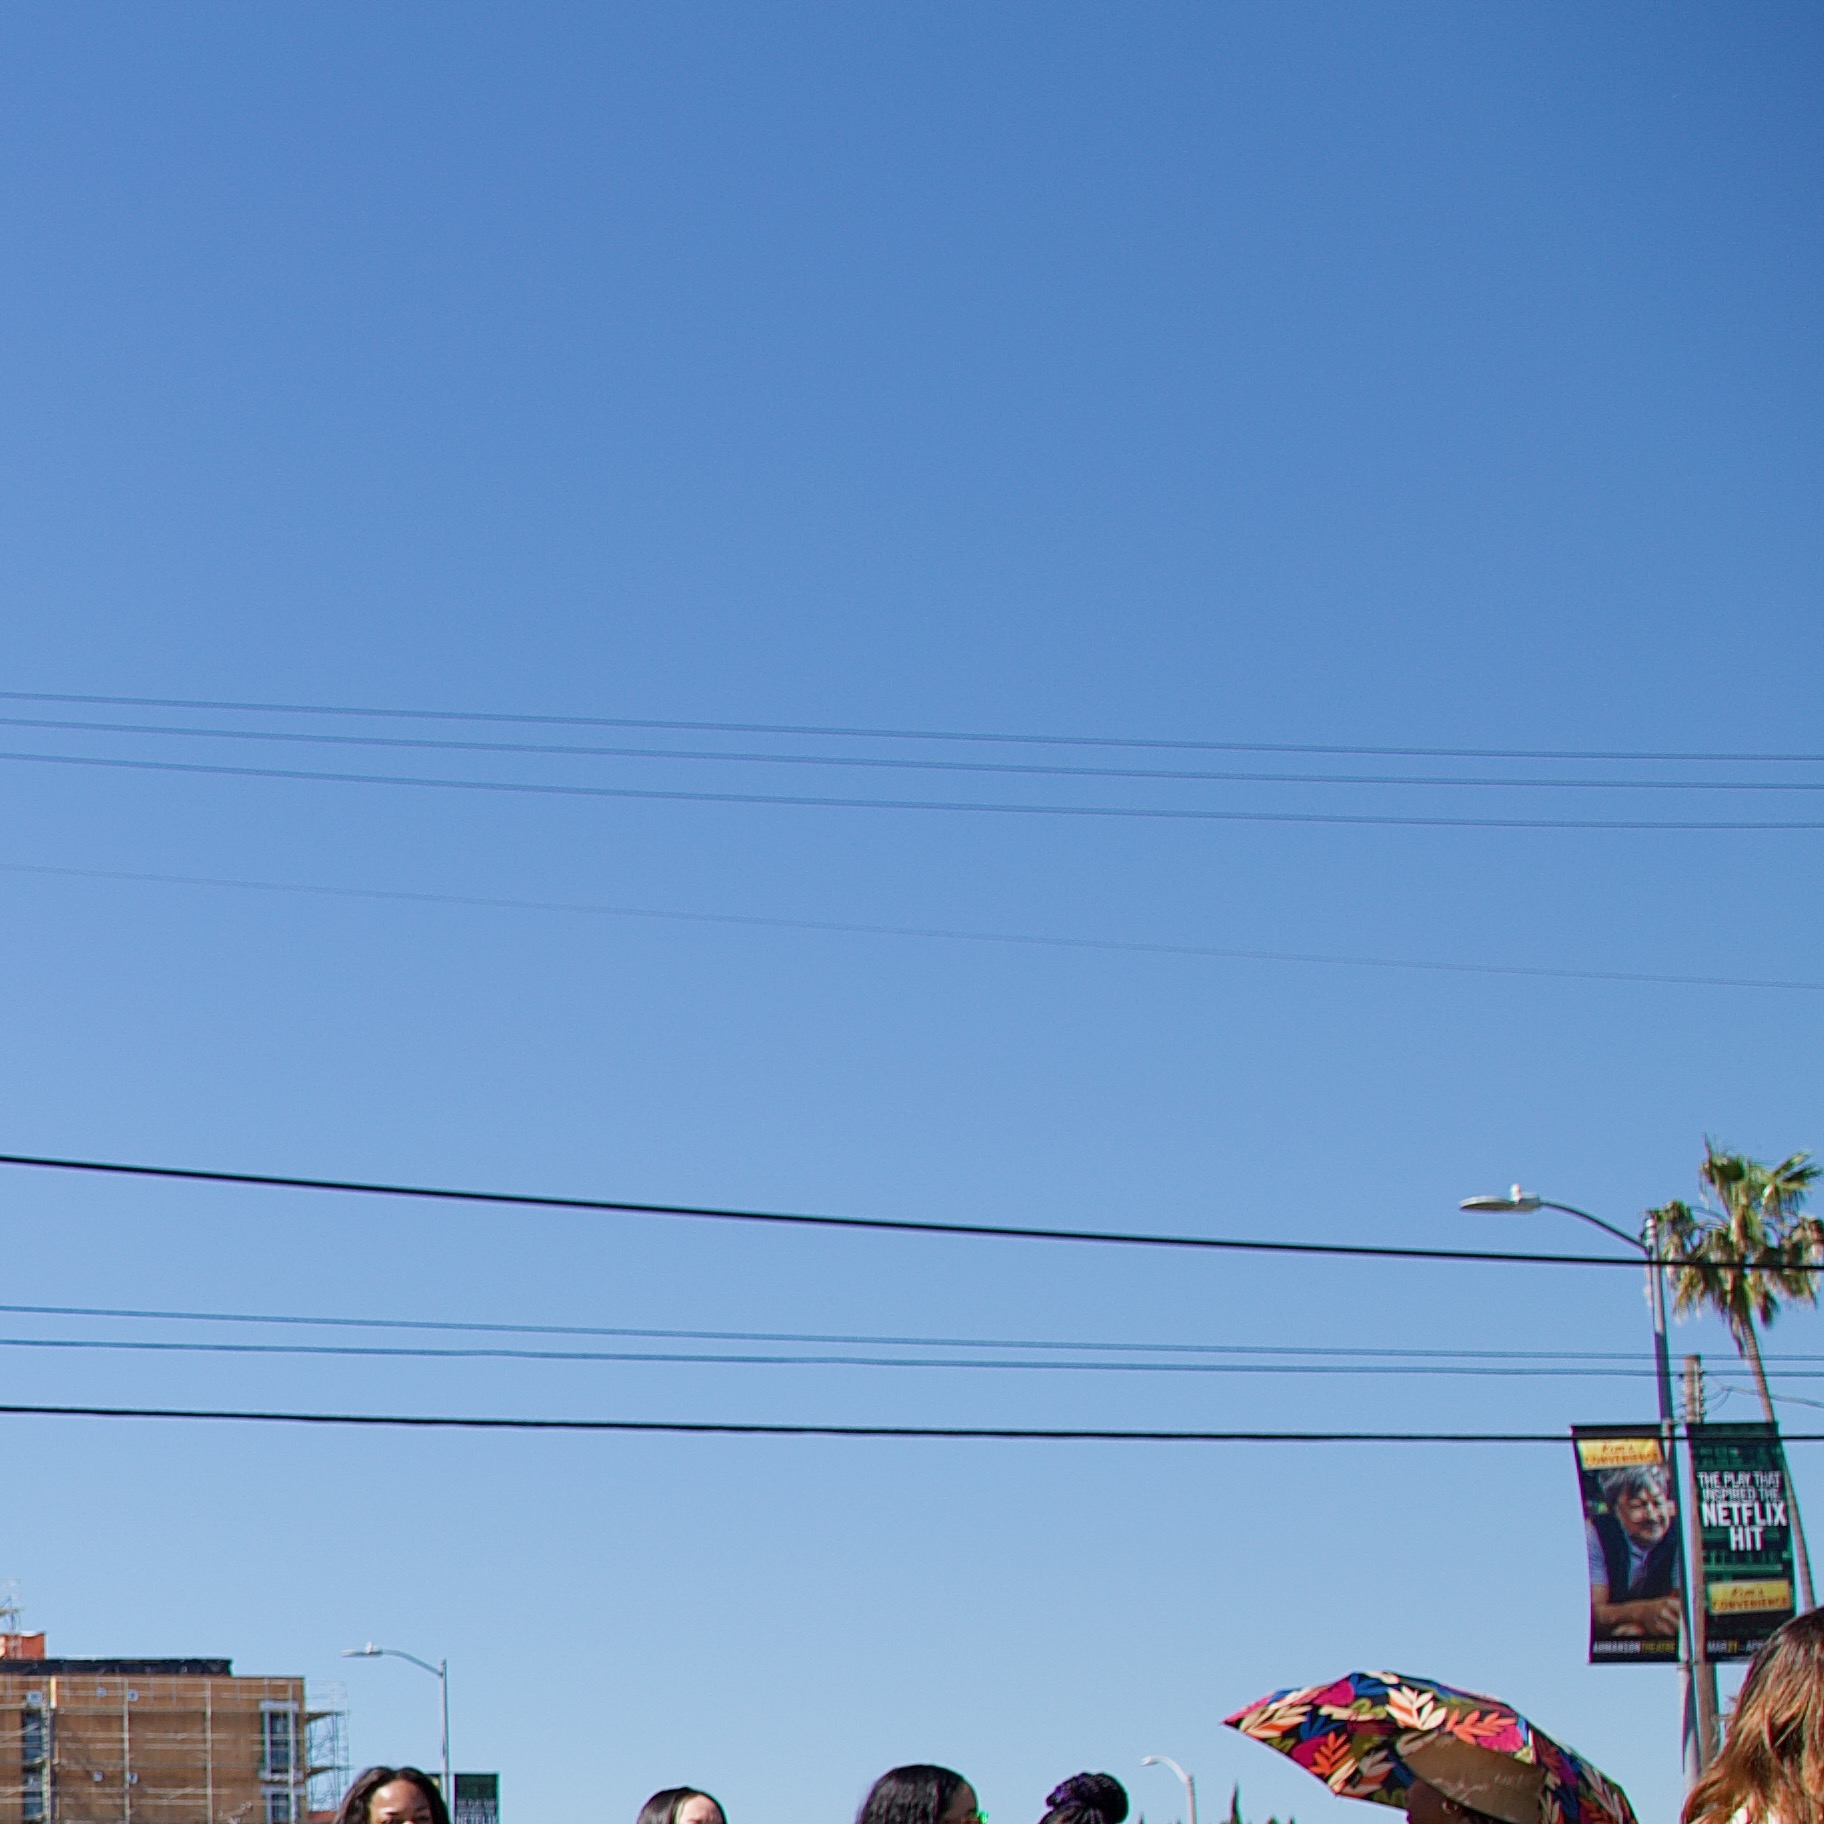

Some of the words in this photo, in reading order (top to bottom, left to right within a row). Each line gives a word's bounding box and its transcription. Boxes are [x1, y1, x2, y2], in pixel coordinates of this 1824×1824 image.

[1697, 1471, 1721, 1488] THE
[1723, 1471, 1752, 1488] PLAY
[1754, 1471, 1782, 1488] THAT
[1702, 1500, 1788, 1527] NETFLIX
[1730, 1526, 1765, 1551] HIT
